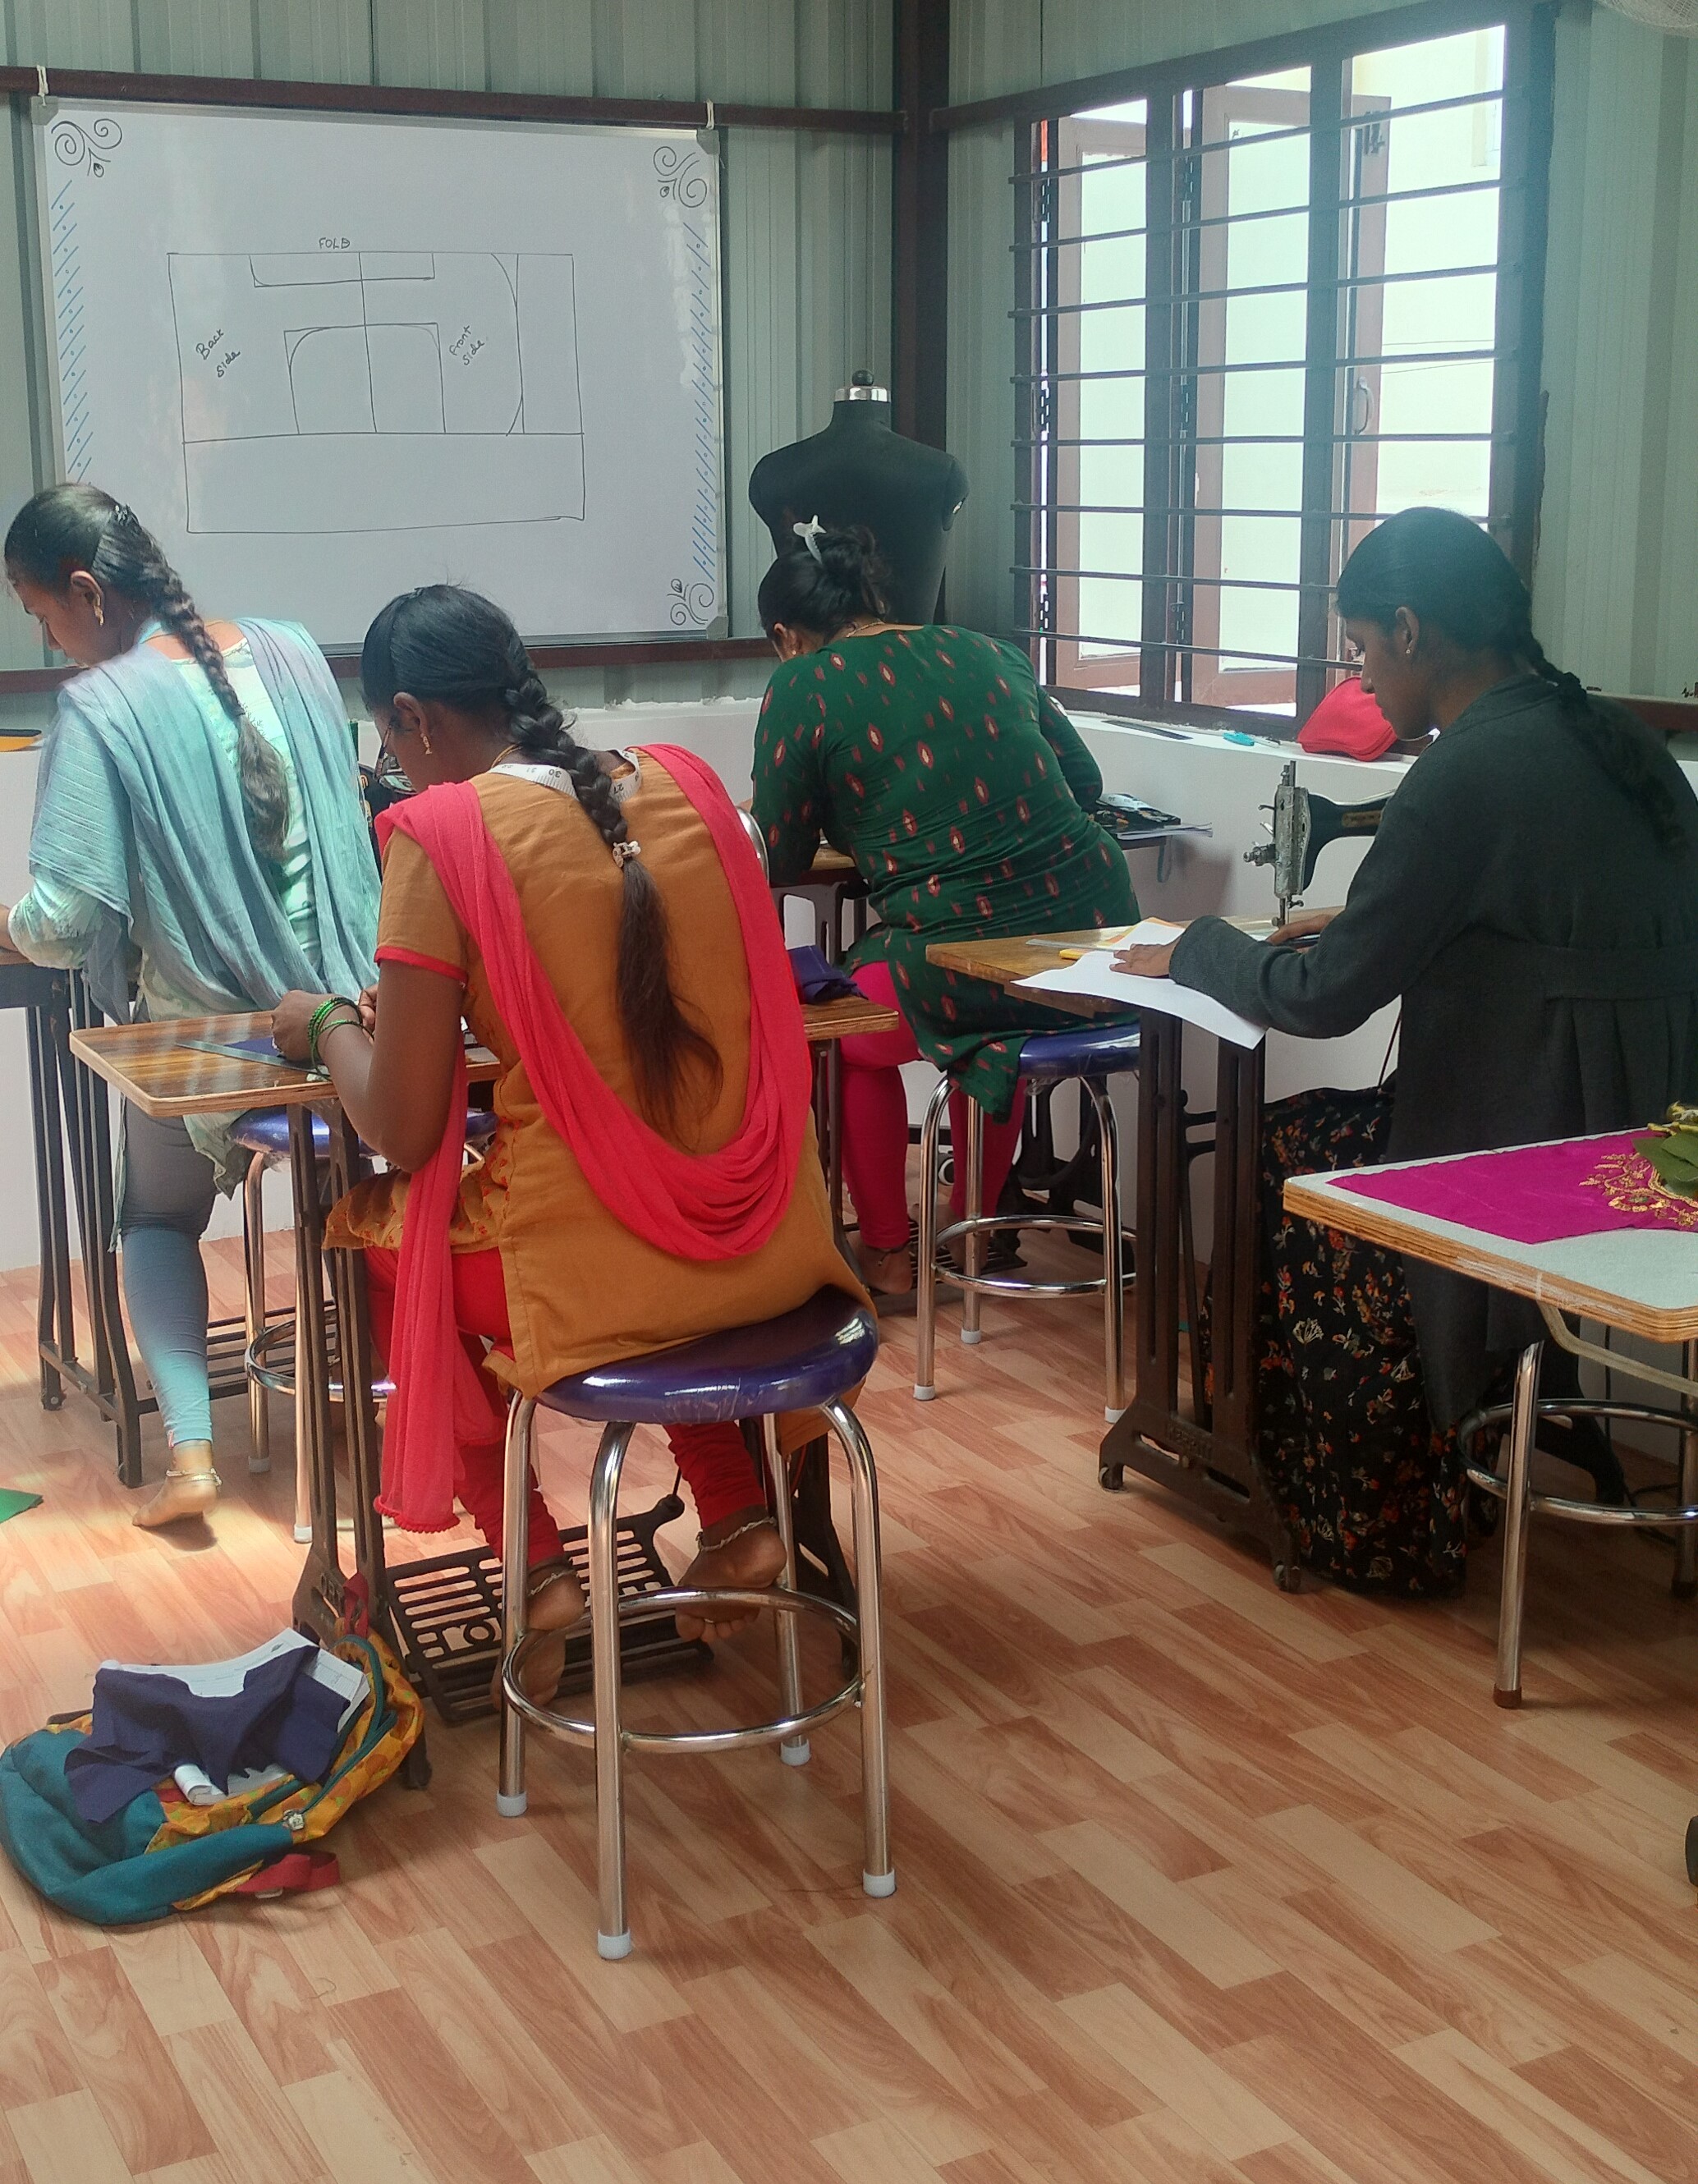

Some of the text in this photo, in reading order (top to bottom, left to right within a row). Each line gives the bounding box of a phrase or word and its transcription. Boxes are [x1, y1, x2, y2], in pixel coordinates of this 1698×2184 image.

[195, 328, 224, 360] Back
[548, 769, 562, 778] 30
[613, 782, 624, 795] 27
